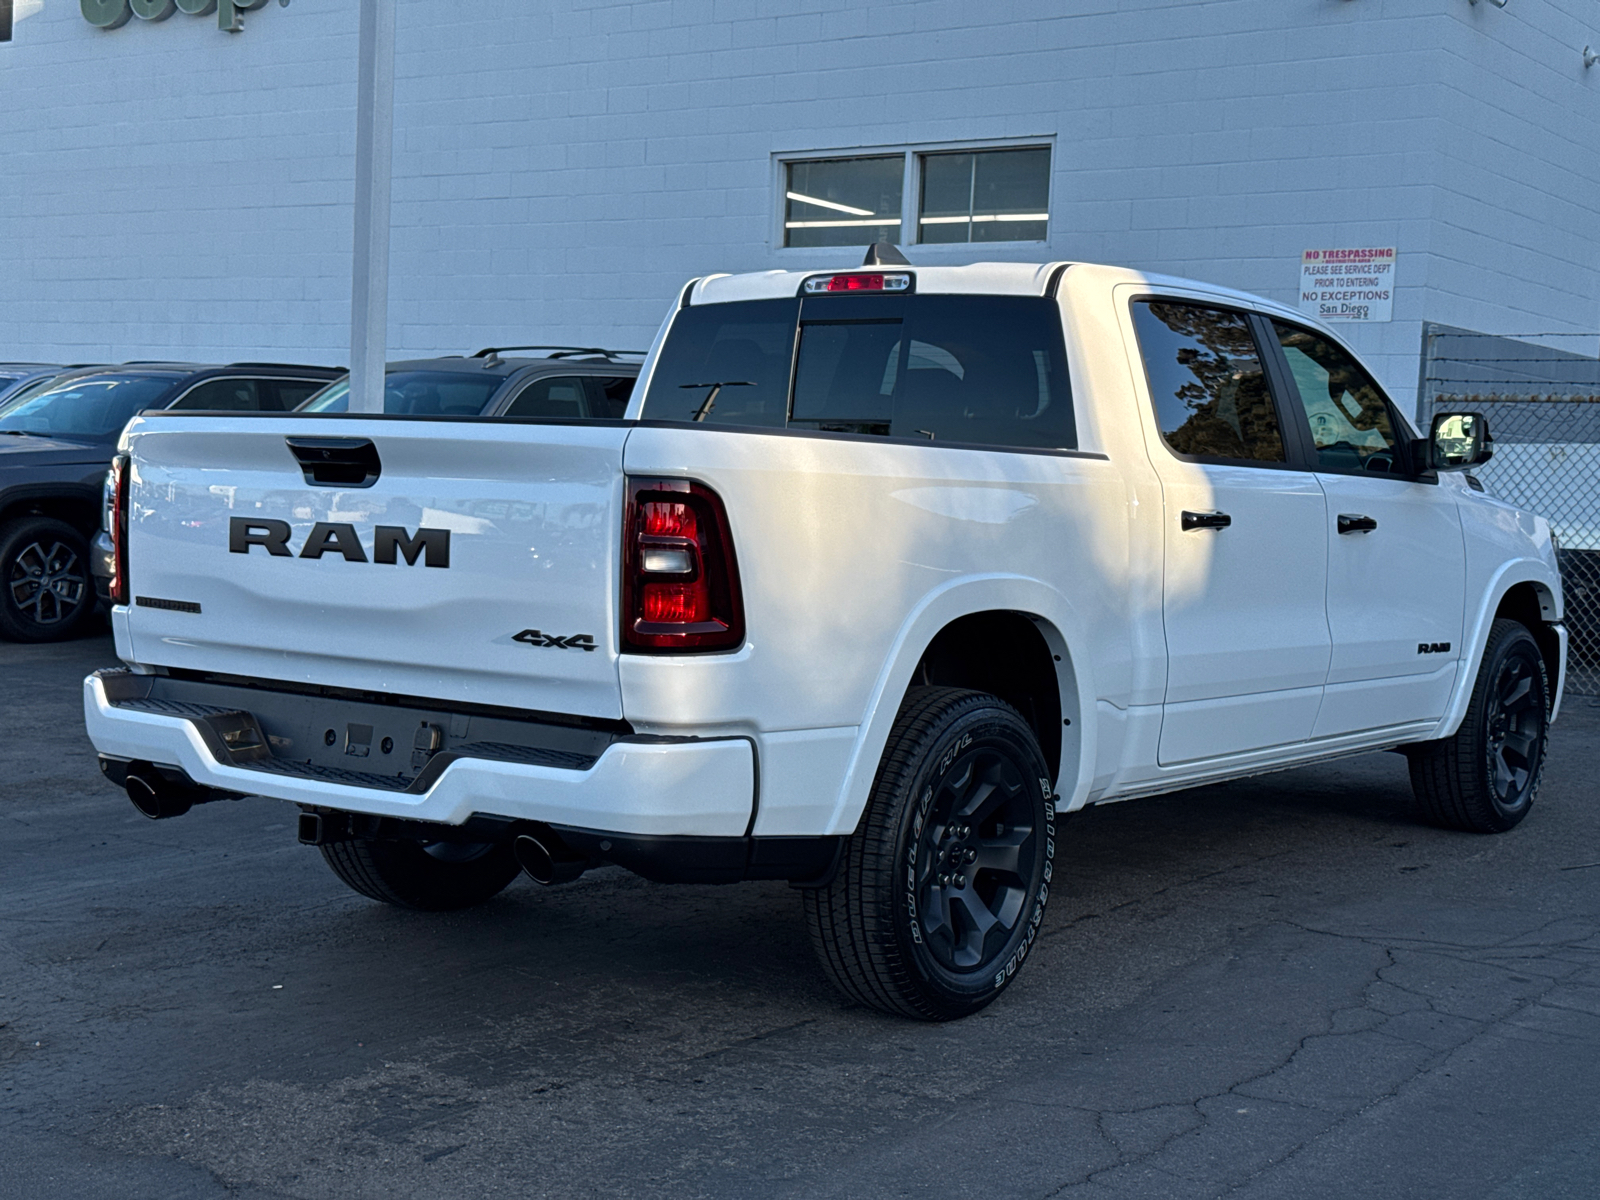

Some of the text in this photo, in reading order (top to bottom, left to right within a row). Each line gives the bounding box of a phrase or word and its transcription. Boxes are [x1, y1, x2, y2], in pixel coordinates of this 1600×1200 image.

[1305, 248, 1393, 260] NO TRESPASSING
[1304, 263, 1391, 276] PLEASE SEE SERVICE DEPT
[1314, 277, 1379, 288] PRIOR TO ENTERING
[1302, 290, 1390, 302] NO EXCEPTIONS
[1319, 302, 1369, 317] San Diego
[229, 516, 452, 569] RAM
[1417, 642, 1451, 655] RAM
[994, 777, 1056, 988] BRIDGESTONE
